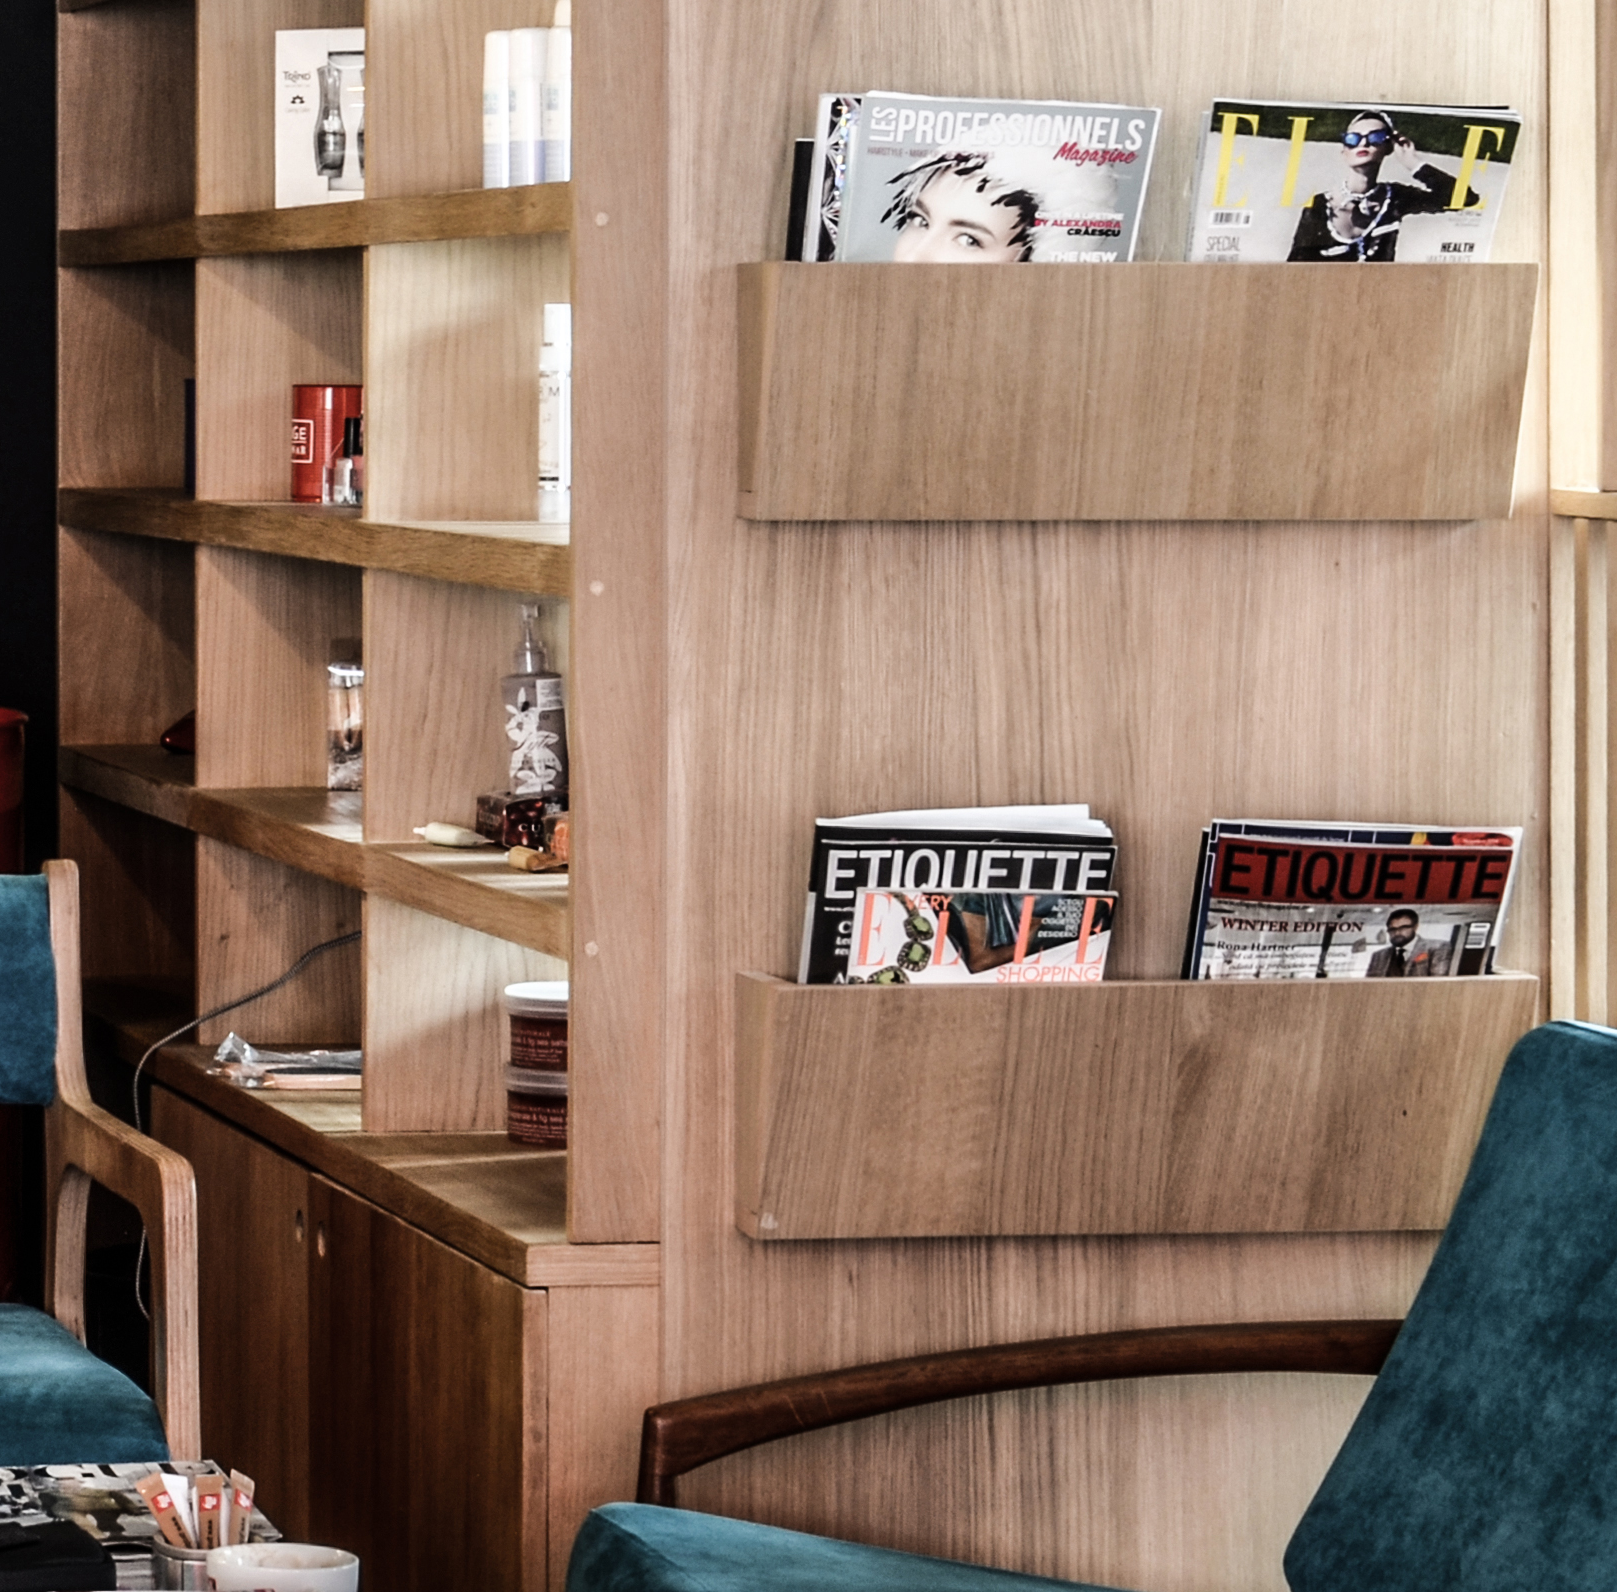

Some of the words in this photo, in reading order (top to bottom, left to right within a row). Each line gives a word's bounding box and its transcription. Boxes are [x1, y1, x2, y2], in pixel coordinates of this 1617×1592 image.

[869, 106, 898, 143] LES
[897, 107, 1147, 151] PROFESSIONNELS
[1054, 142, 1139, 167] Magazine
[1440, 242, 1475, 253] HEALTH
[824, 849, 1112, 899] ETIQUETTE
[1218, 844, 1508, 902] ETIQUETTE
[1221, 916, 1289, 933] WINTER
[1293, 921, 1365, 933] EDITION
[996, 964, 1101, 984] SHOPPING
